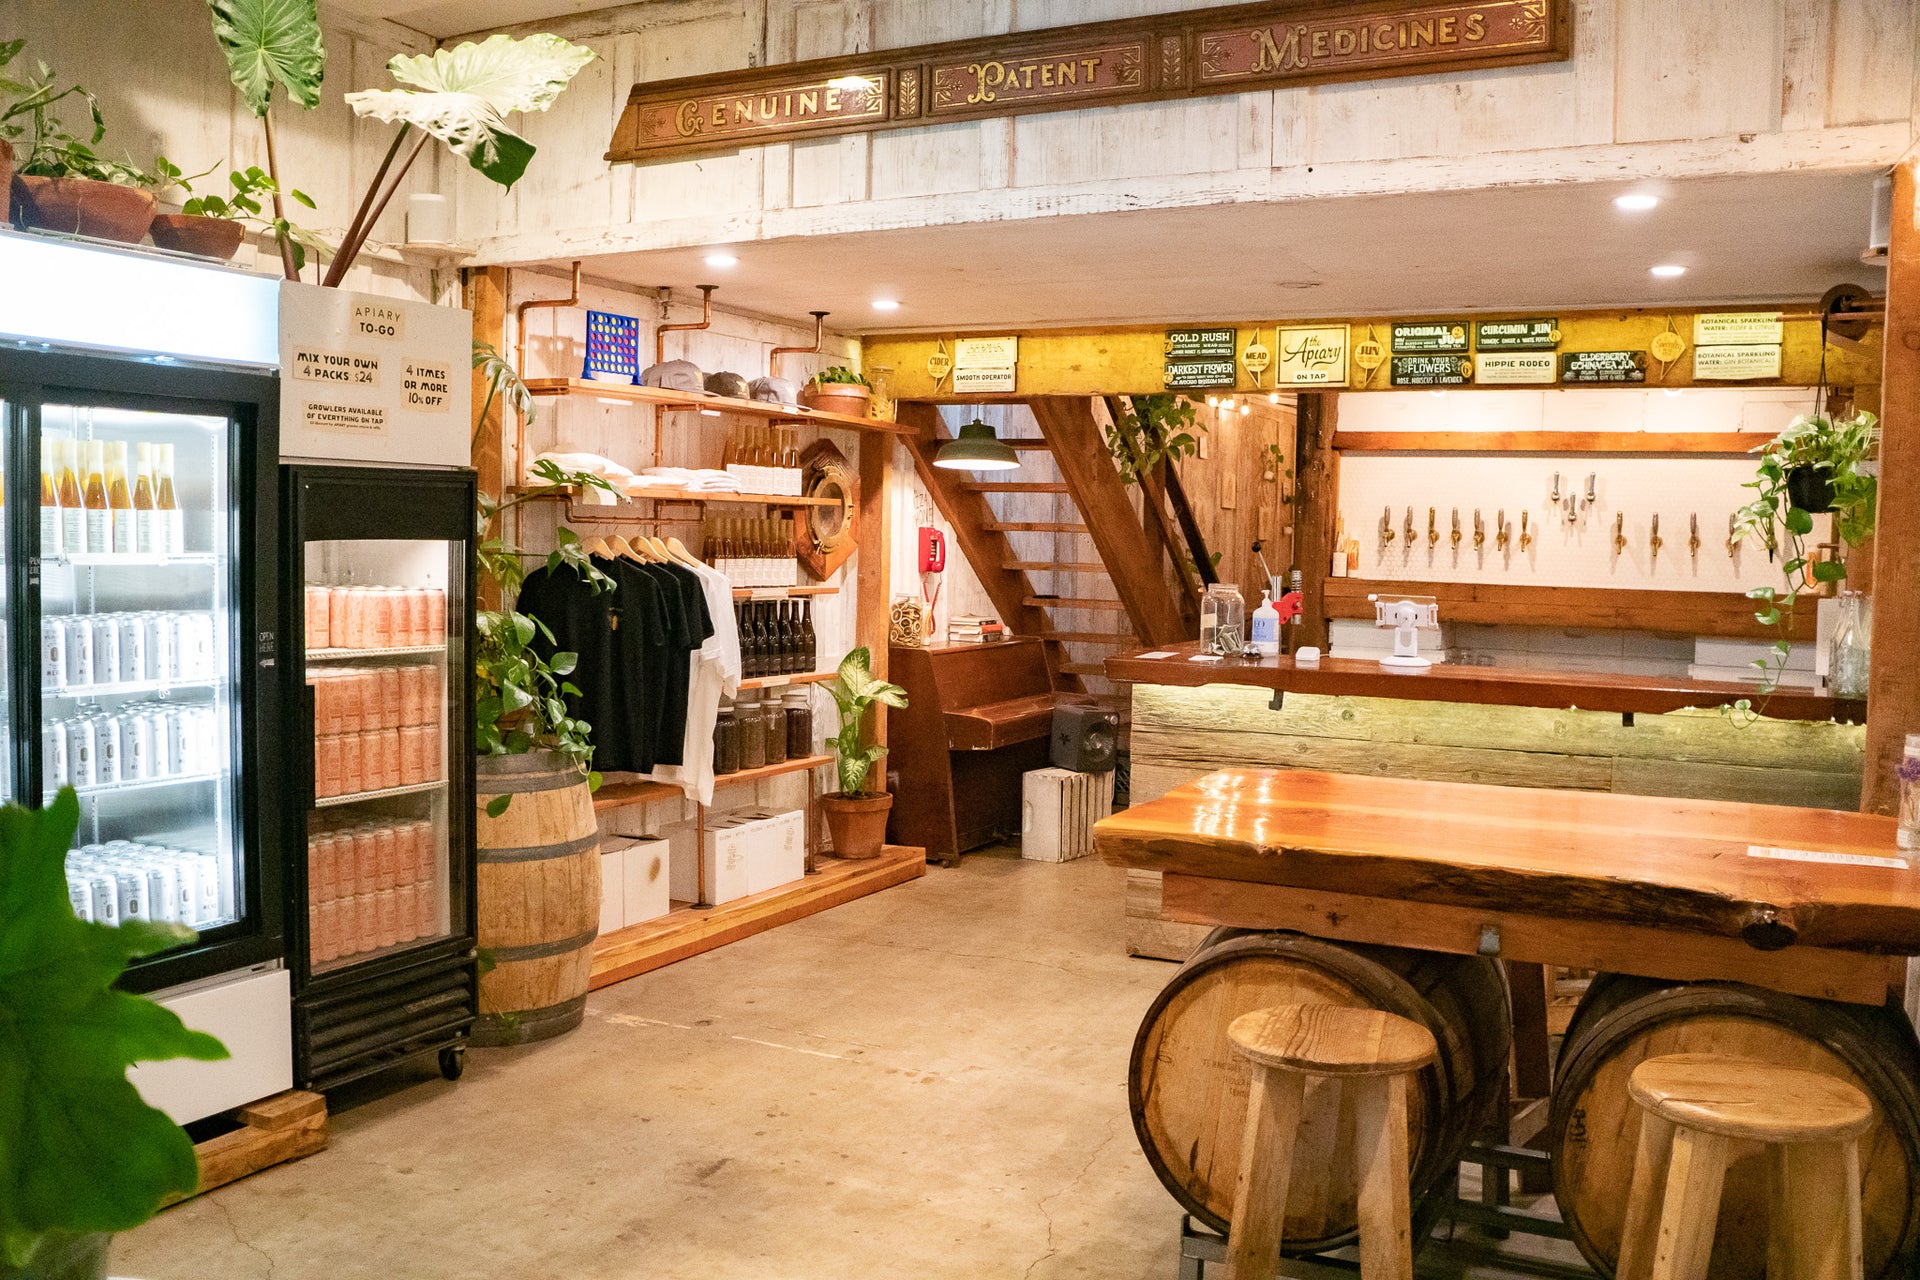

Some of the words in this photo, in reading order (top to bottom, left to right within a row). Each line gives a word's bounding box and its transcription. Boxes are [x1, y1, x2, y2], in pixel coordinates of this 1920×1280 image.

[675, 87, 842, 137] GENUINE
[967, 60, 1101, 104] PATENT
[1250, 13, 1486, 73] MEDICINES
[355, 307, 400, 322] APIARY
[360, 322, 395, 336] TO-GO
[1395, 326, 1450, 336] ORIGINAL
[1481, 324, 1528, 335] CURCUMIN
[1531, 323, 1552, 335] JUN
[1171, 334, 1199, 342] GOLD
[1201, 332, 1230, 341] RUSH
[1246, 352, 1267, 360] MEAD
[1359, 346, 1380, 356] JUN
[297, 352, 319, 363] MIX
[323, 355, 350, 366] YOUR
[354, 358, 378, 370] OWN
[930, 356, 950, 366] CIDER
[1432, 356, 1450, 364] YOUR
[303, 365, 311, 377] 4
[406, 364, 413, 376] 4
[416, 368, 446, 379] ITMES
[1168, 364, 1203, 374] DARKEST
[1203, 363, 1233, 374] FLOWER
[1407, 363, 1451, 373] FLOWERS
[404, 380, 417, 390] OR
[421, 382, 448, 393] MORE
[409, 392, 424, 404] 10%
[425, 396, 443, 406] OFF
[308, 403, 347, 413] GROWLERS
[348, 407, 383, 416] AVAILABLE
[317, 413, 360, 423] EVERYTHING
